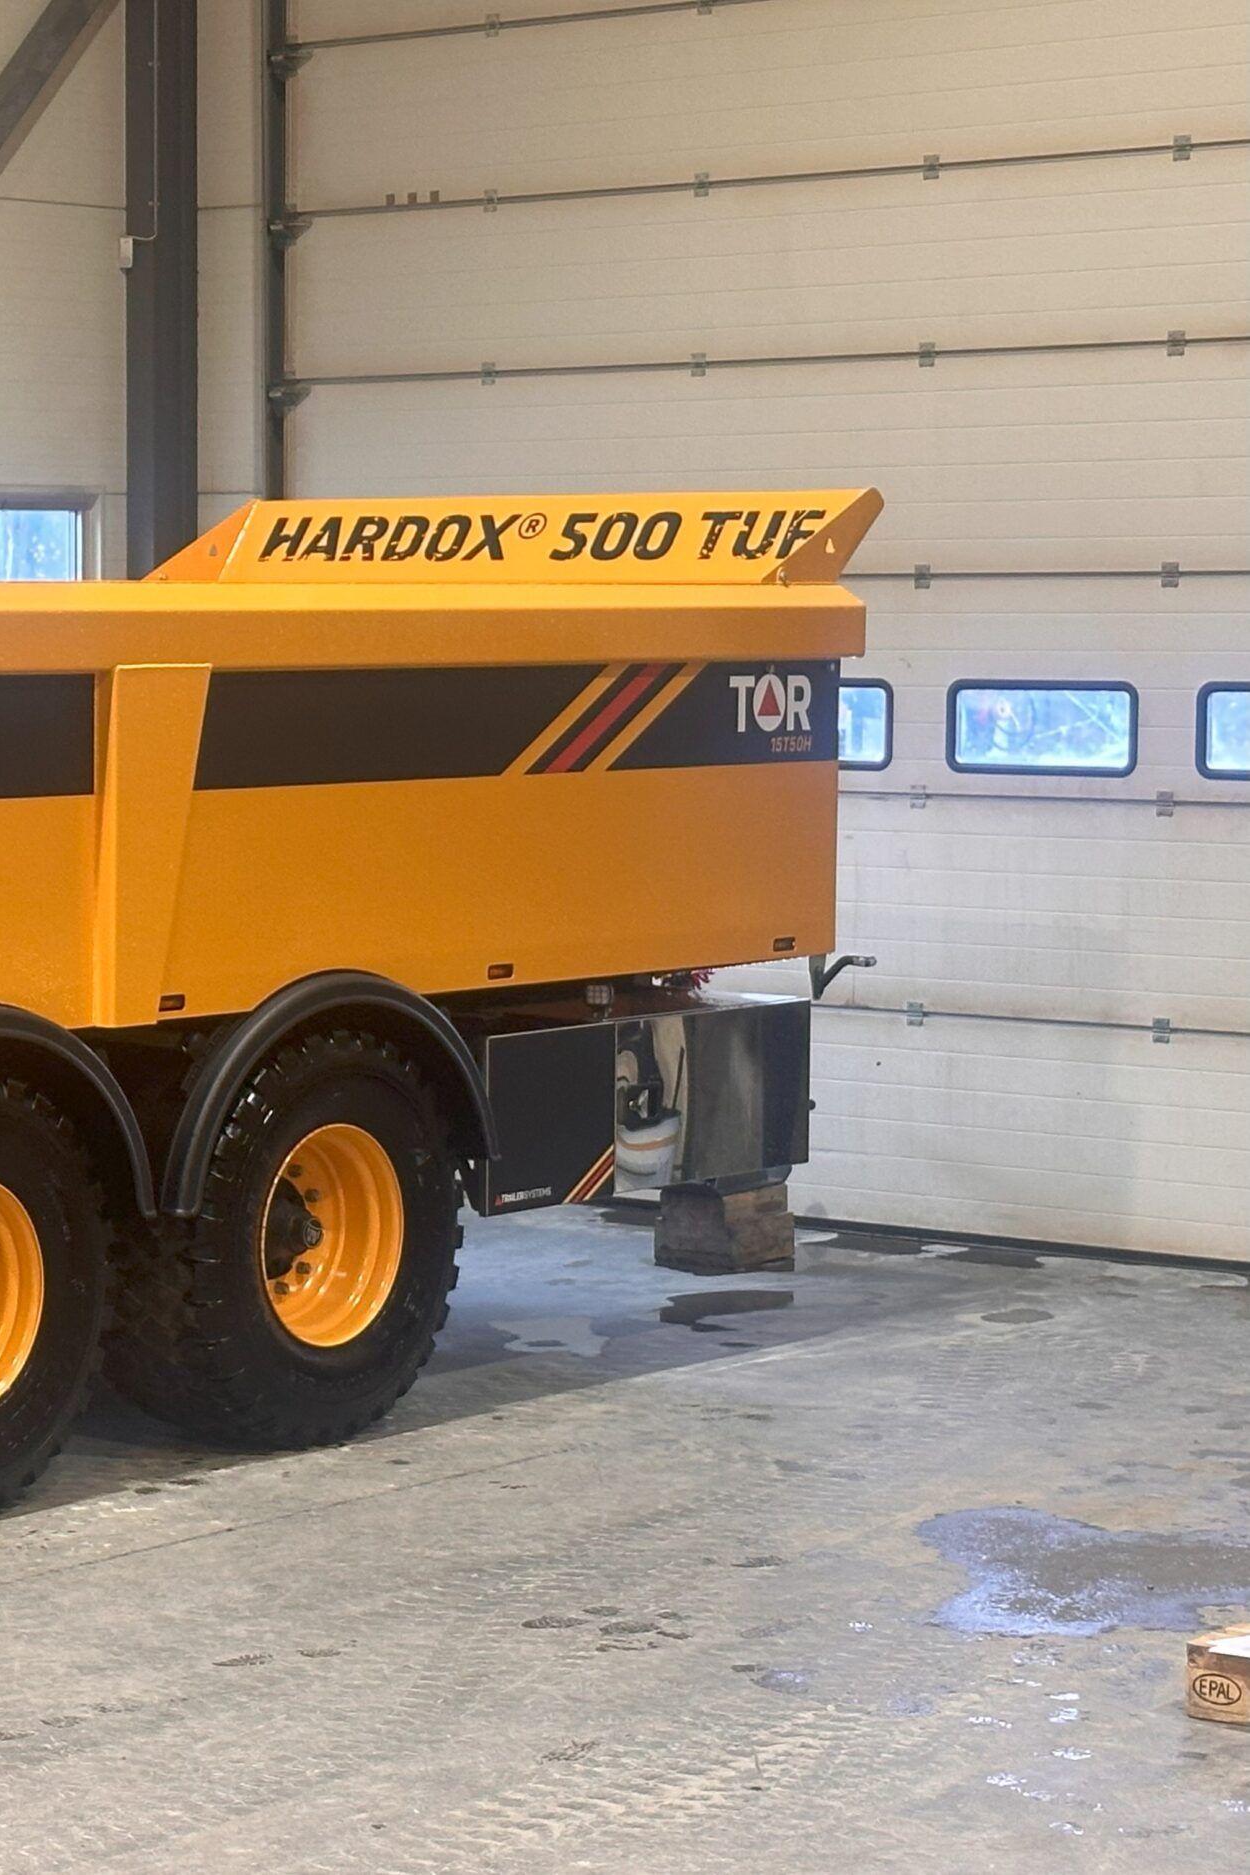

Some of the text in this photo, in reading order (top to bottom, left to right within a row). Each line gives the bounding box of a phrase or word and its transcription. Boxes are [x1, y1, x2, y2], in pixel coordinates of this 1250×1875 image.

[549, 511, 683, 561] 500
[697, 510, 827, 560] TUF
[729, 673, 812, 733] TOR
[1198, 1678, 1234, 1701] EPAL
